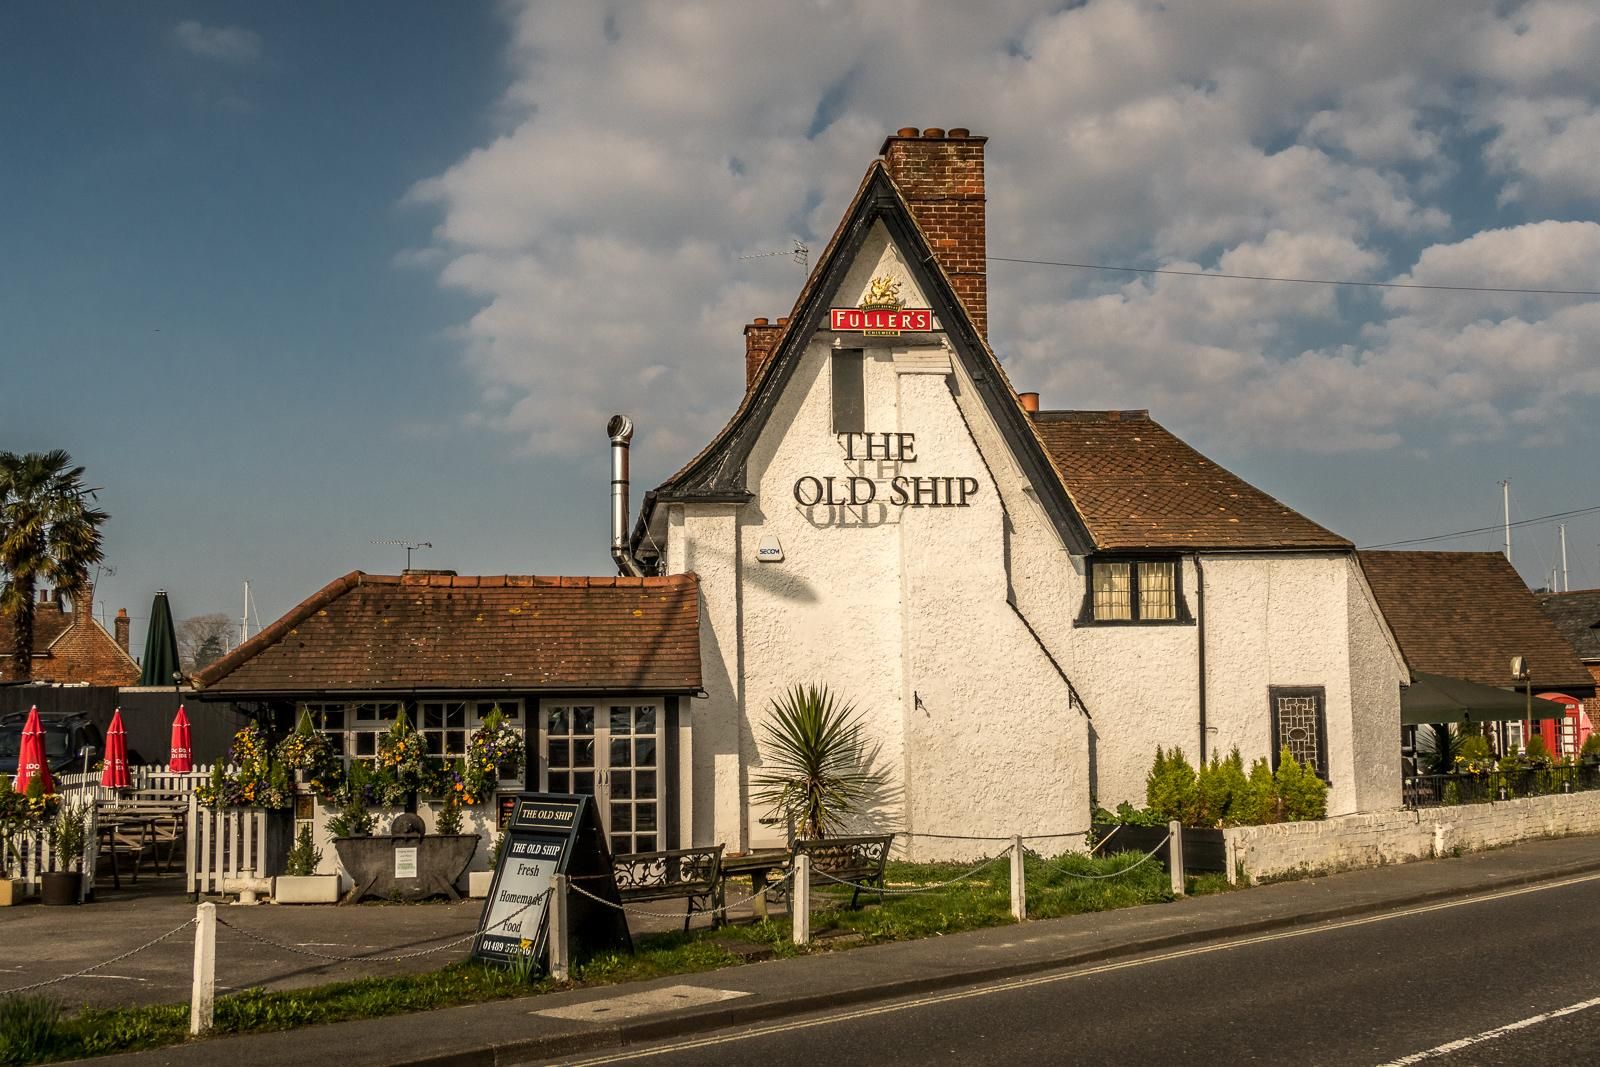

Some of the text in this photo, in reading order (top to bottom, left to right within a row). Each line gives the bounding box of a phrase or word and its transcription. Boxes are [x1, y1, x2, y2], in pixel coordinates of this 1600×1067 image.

[836, 311, 926, 329] FULLER'S
[837, 432, 917, 462] THE
[793, 475, 979, 508] OLD SHIP
[522, 809, 538, 818] THE
[538, 810, 554, 819] OLD
[554, 811, 573, 821] SHIP
[512, 843, 561, 856] THE OLD SHIP
[517, 863, 540, 876] Fresh
[499, 890, 543, 906] Homemade
[502, 920, 523, 933] Food
[482, 940, 504, 952] 01489
